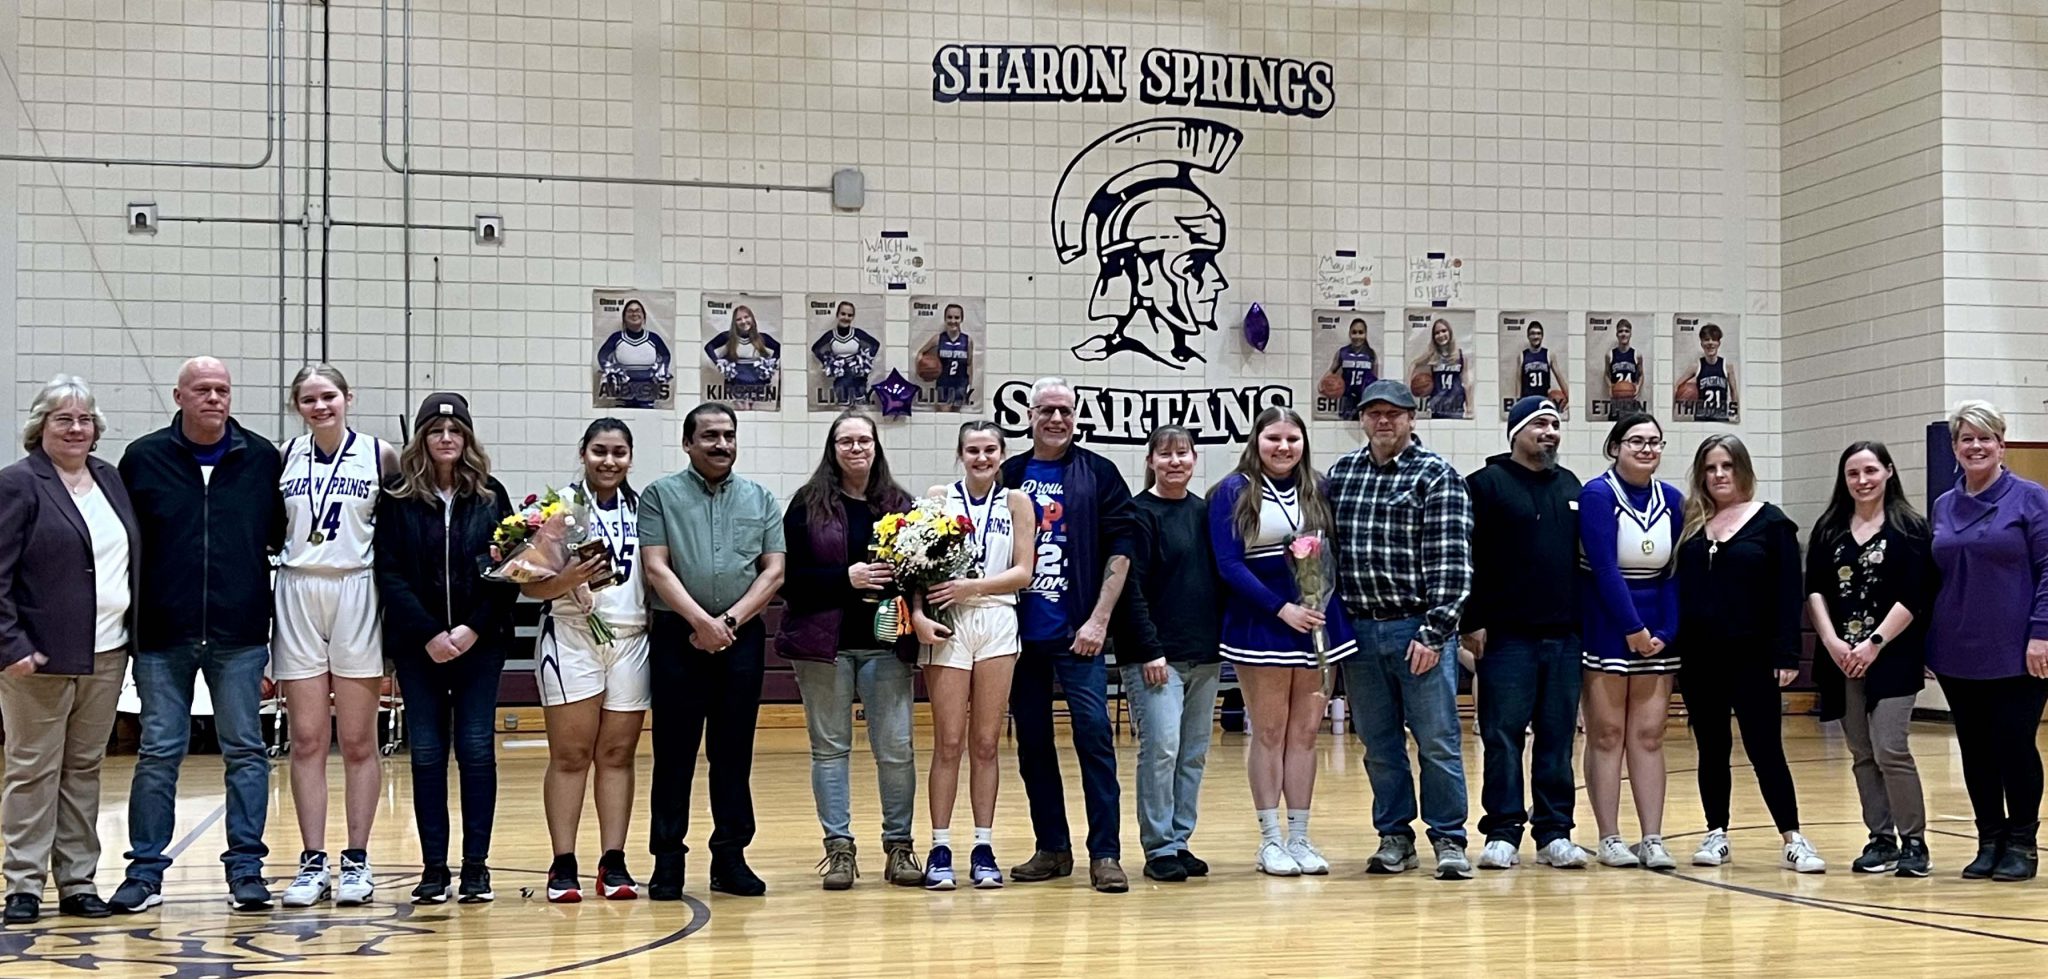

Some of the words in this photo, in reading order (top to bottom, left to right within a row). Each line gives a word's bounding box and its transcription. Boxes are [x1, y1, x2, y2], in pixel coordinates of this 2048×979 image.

[933, 45, 1126, 102] SHARON
[1140, 48, 1335, 118] SPRINGS
[949, 360, 959, 375] 2
[1350, 370, 1364, 386] 15
[1441, 373, 1453, 390] 14
[1529, 372, 1543, 387] 31
[1616, 372, 1632, 382] 24
[707, 384, 777, 401] KIRSTEN
[1704, 390, 1720, 408] 21
[994, 381, 1293, 446] SARTAN
[1675, 400, 1738, 416] THOMAS
[327, 477, 371, 499] PRINGS
[1021, 480, 1064, 495] Prou
[313, 502, 343, 541] 4
